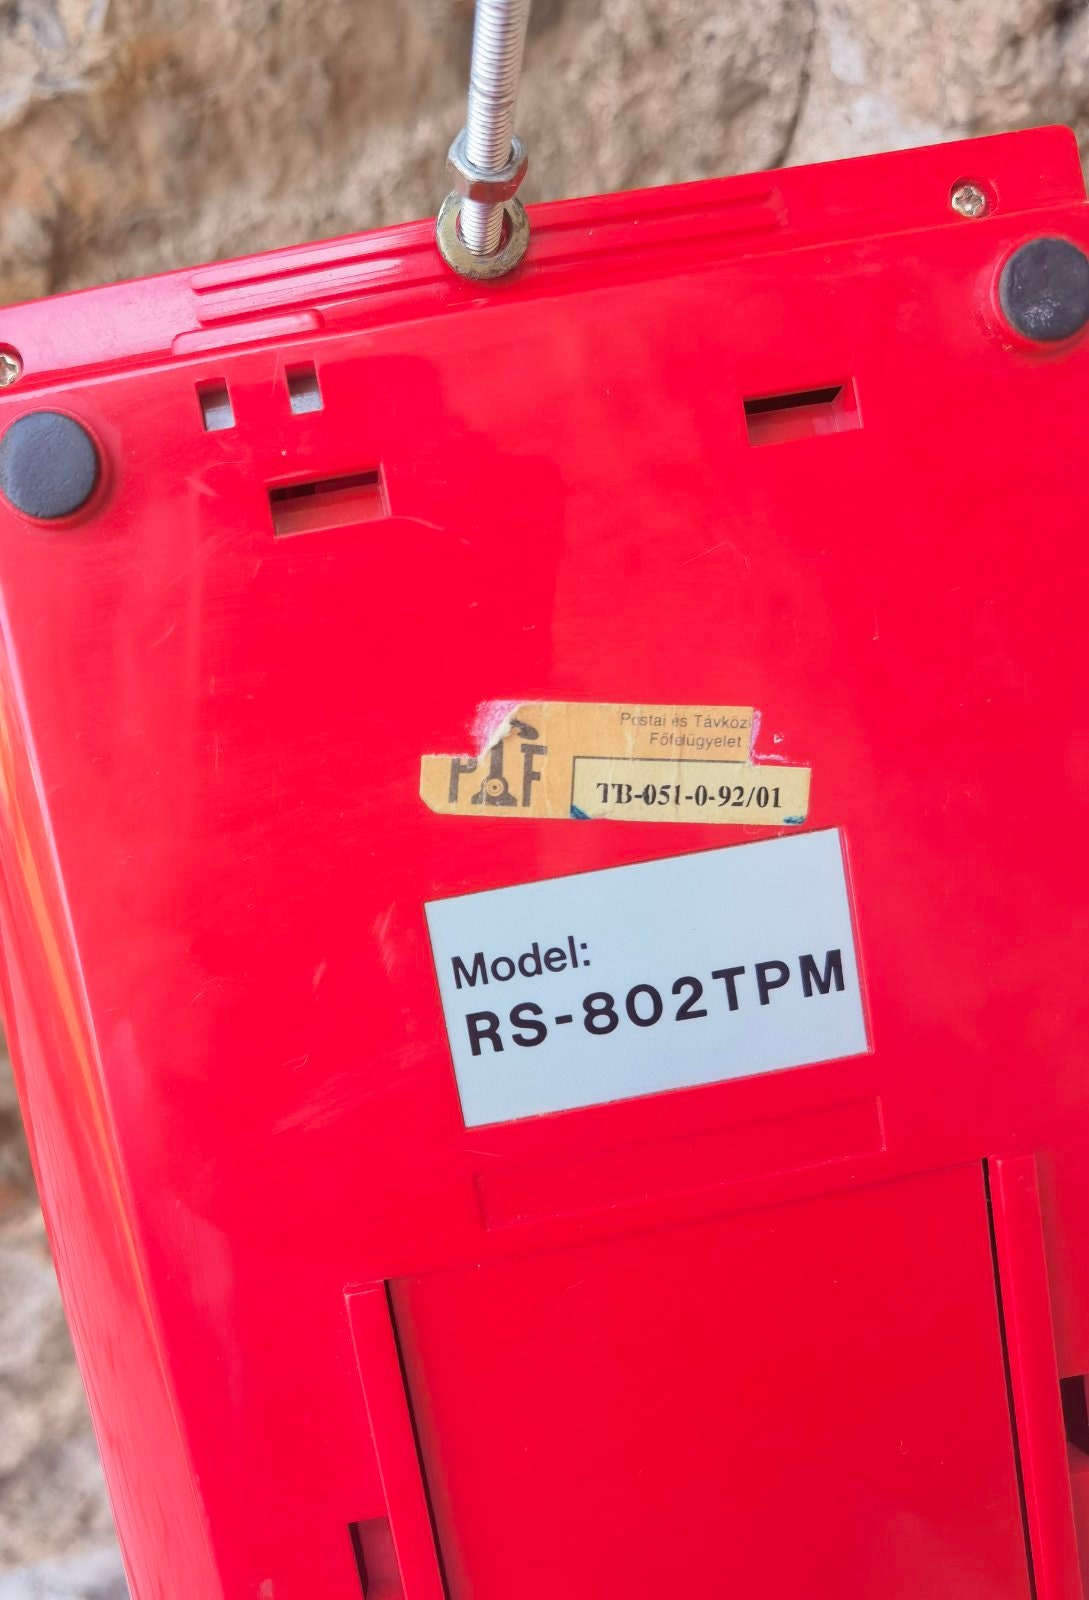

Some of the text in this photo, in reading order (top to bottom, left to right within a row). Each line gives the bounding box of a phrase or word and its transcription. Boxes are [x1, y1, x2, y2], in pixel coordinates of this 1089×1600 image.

[620, 712, 666, 727] Postai
[672, 713, 688, 727] és
[596, 782, 782, 808] TB-051-0-92/01
[450, 936, 591, 989] Model:
[465, 949, 845, 1056] RS-802TPM
